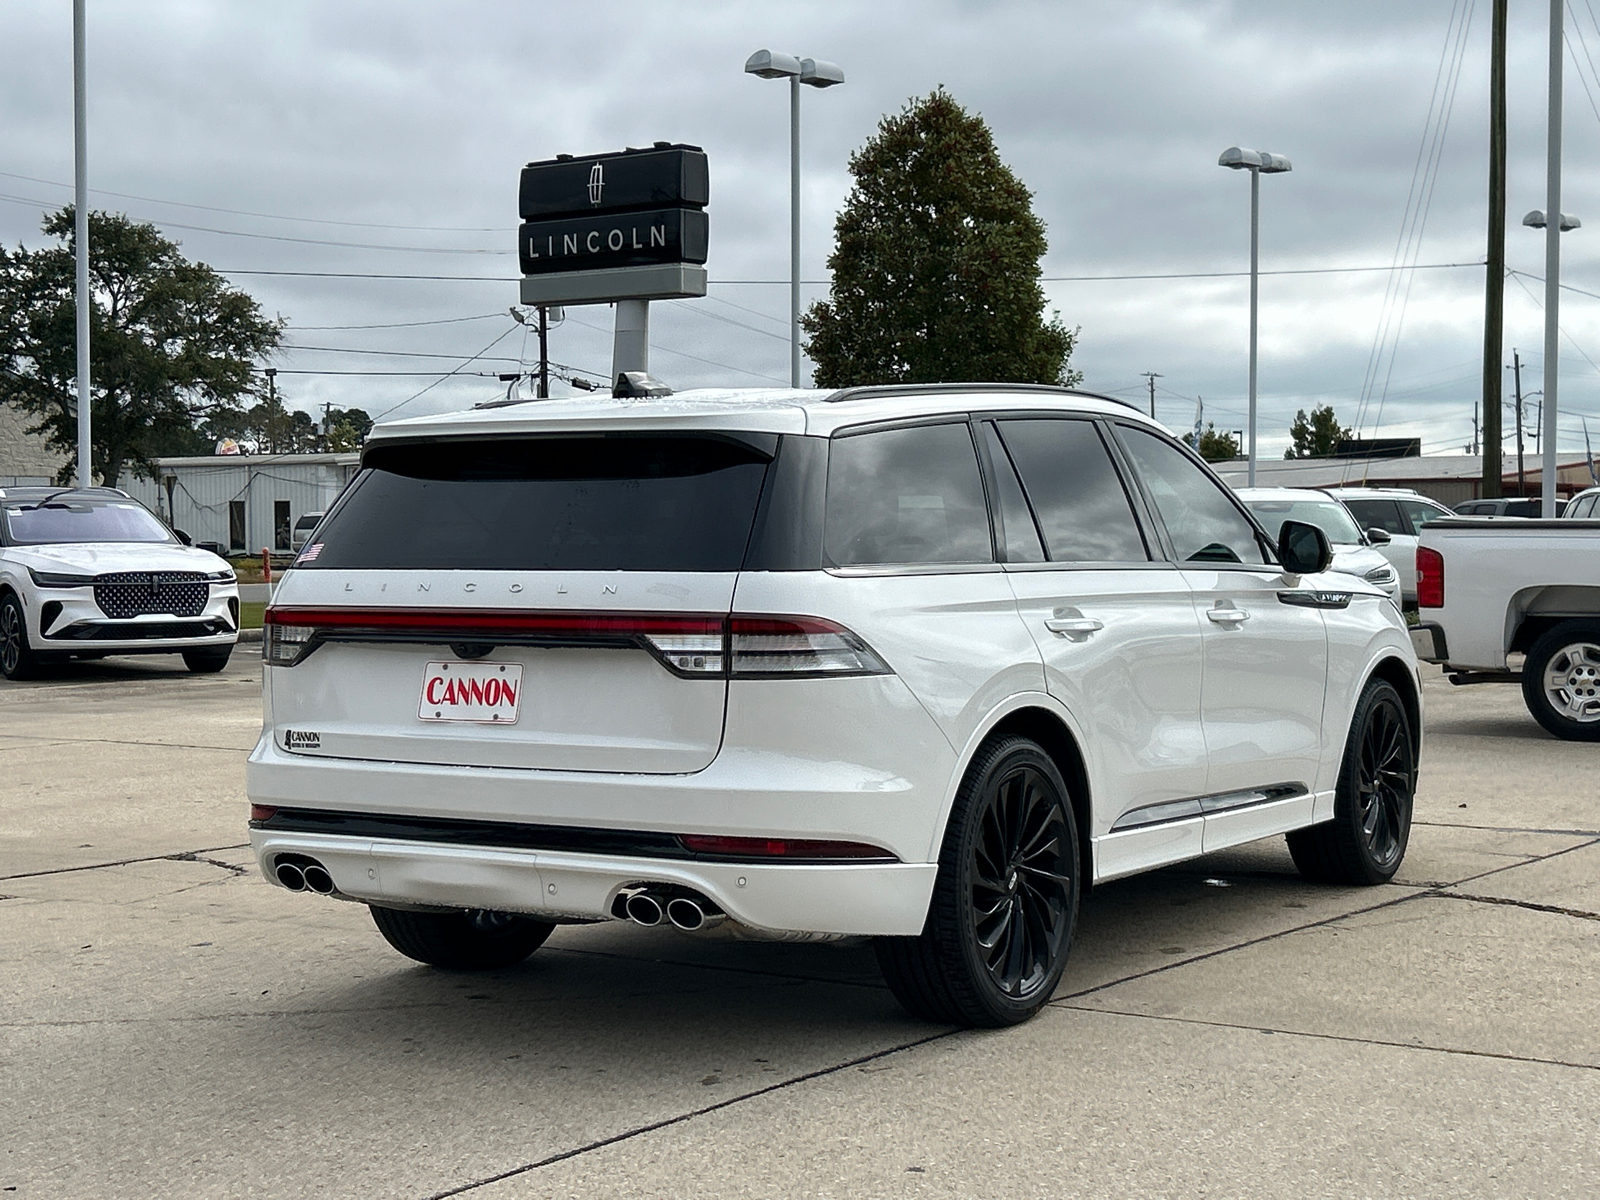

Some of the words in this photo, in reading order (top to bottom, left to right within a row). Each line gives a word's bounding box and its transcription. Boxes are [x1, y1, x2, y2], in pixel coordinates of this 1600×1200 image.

[529, 225, 666, 258] LINCOLN
[344, 582, 618, 595] LINCOLN
[426, 676, 518, 707] CANNON
